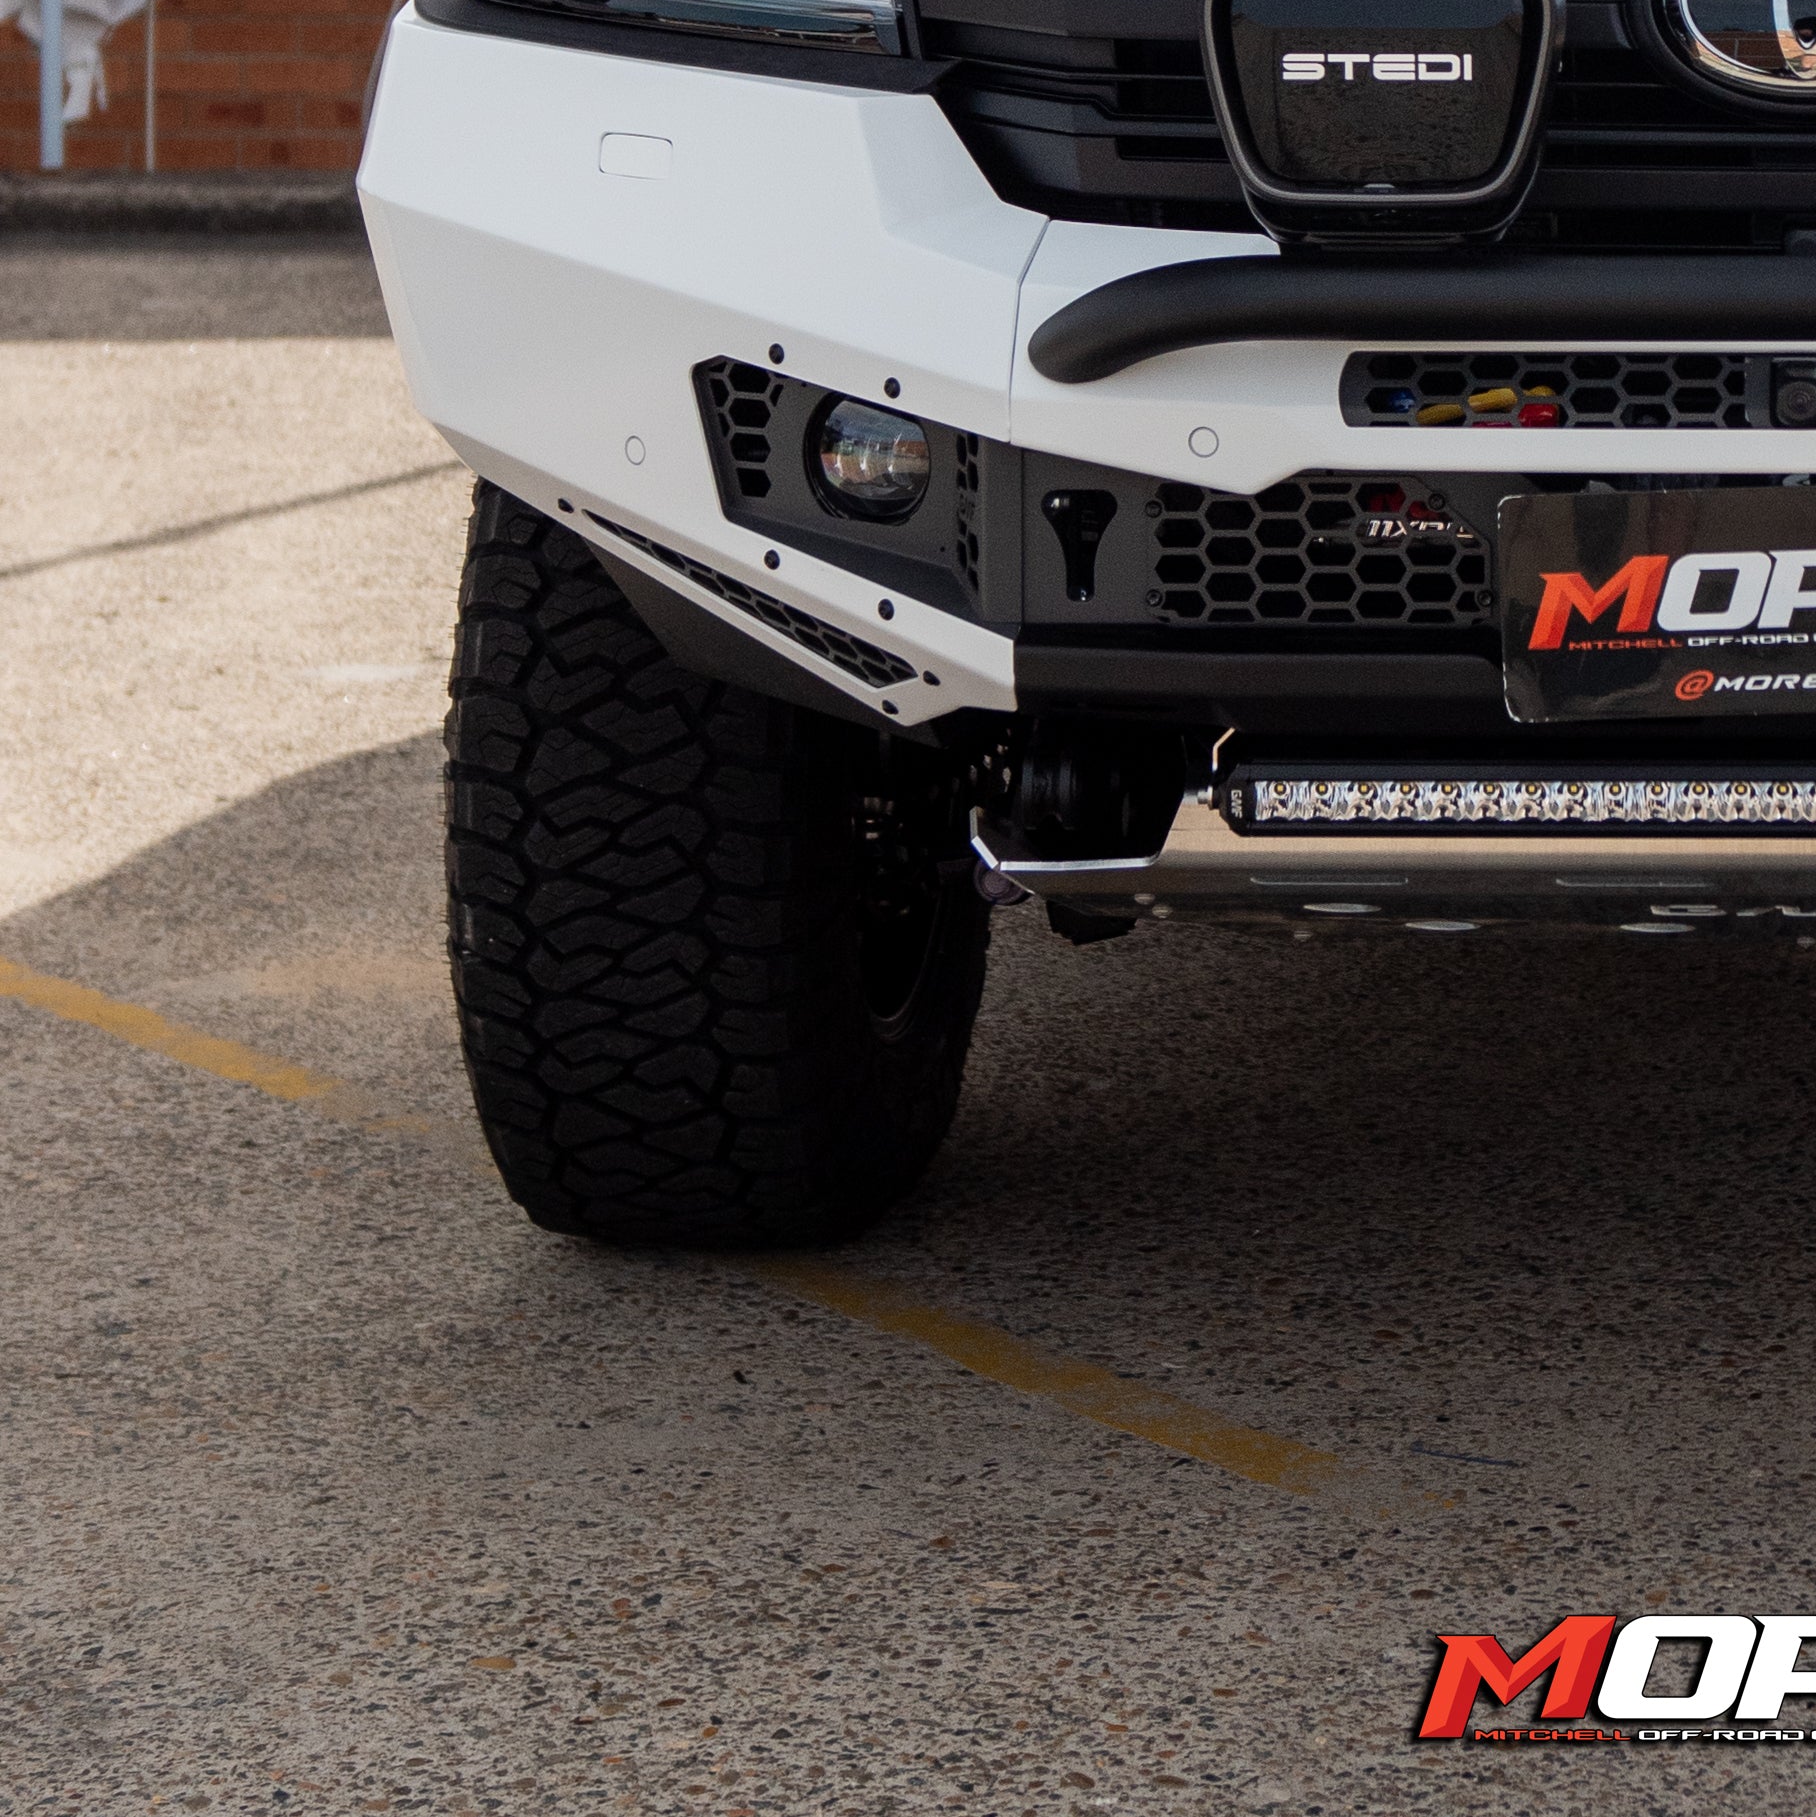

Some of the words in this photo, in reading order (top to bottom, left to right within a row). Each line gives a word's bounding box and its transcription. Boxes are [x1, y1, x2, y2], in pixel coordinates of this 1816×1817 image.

[1282, 53, 1472, 81] STEDI
[1569, 638, 1683, 651] MITCHELL
[1687, 633, 1809, 647] OFF-ROAD
